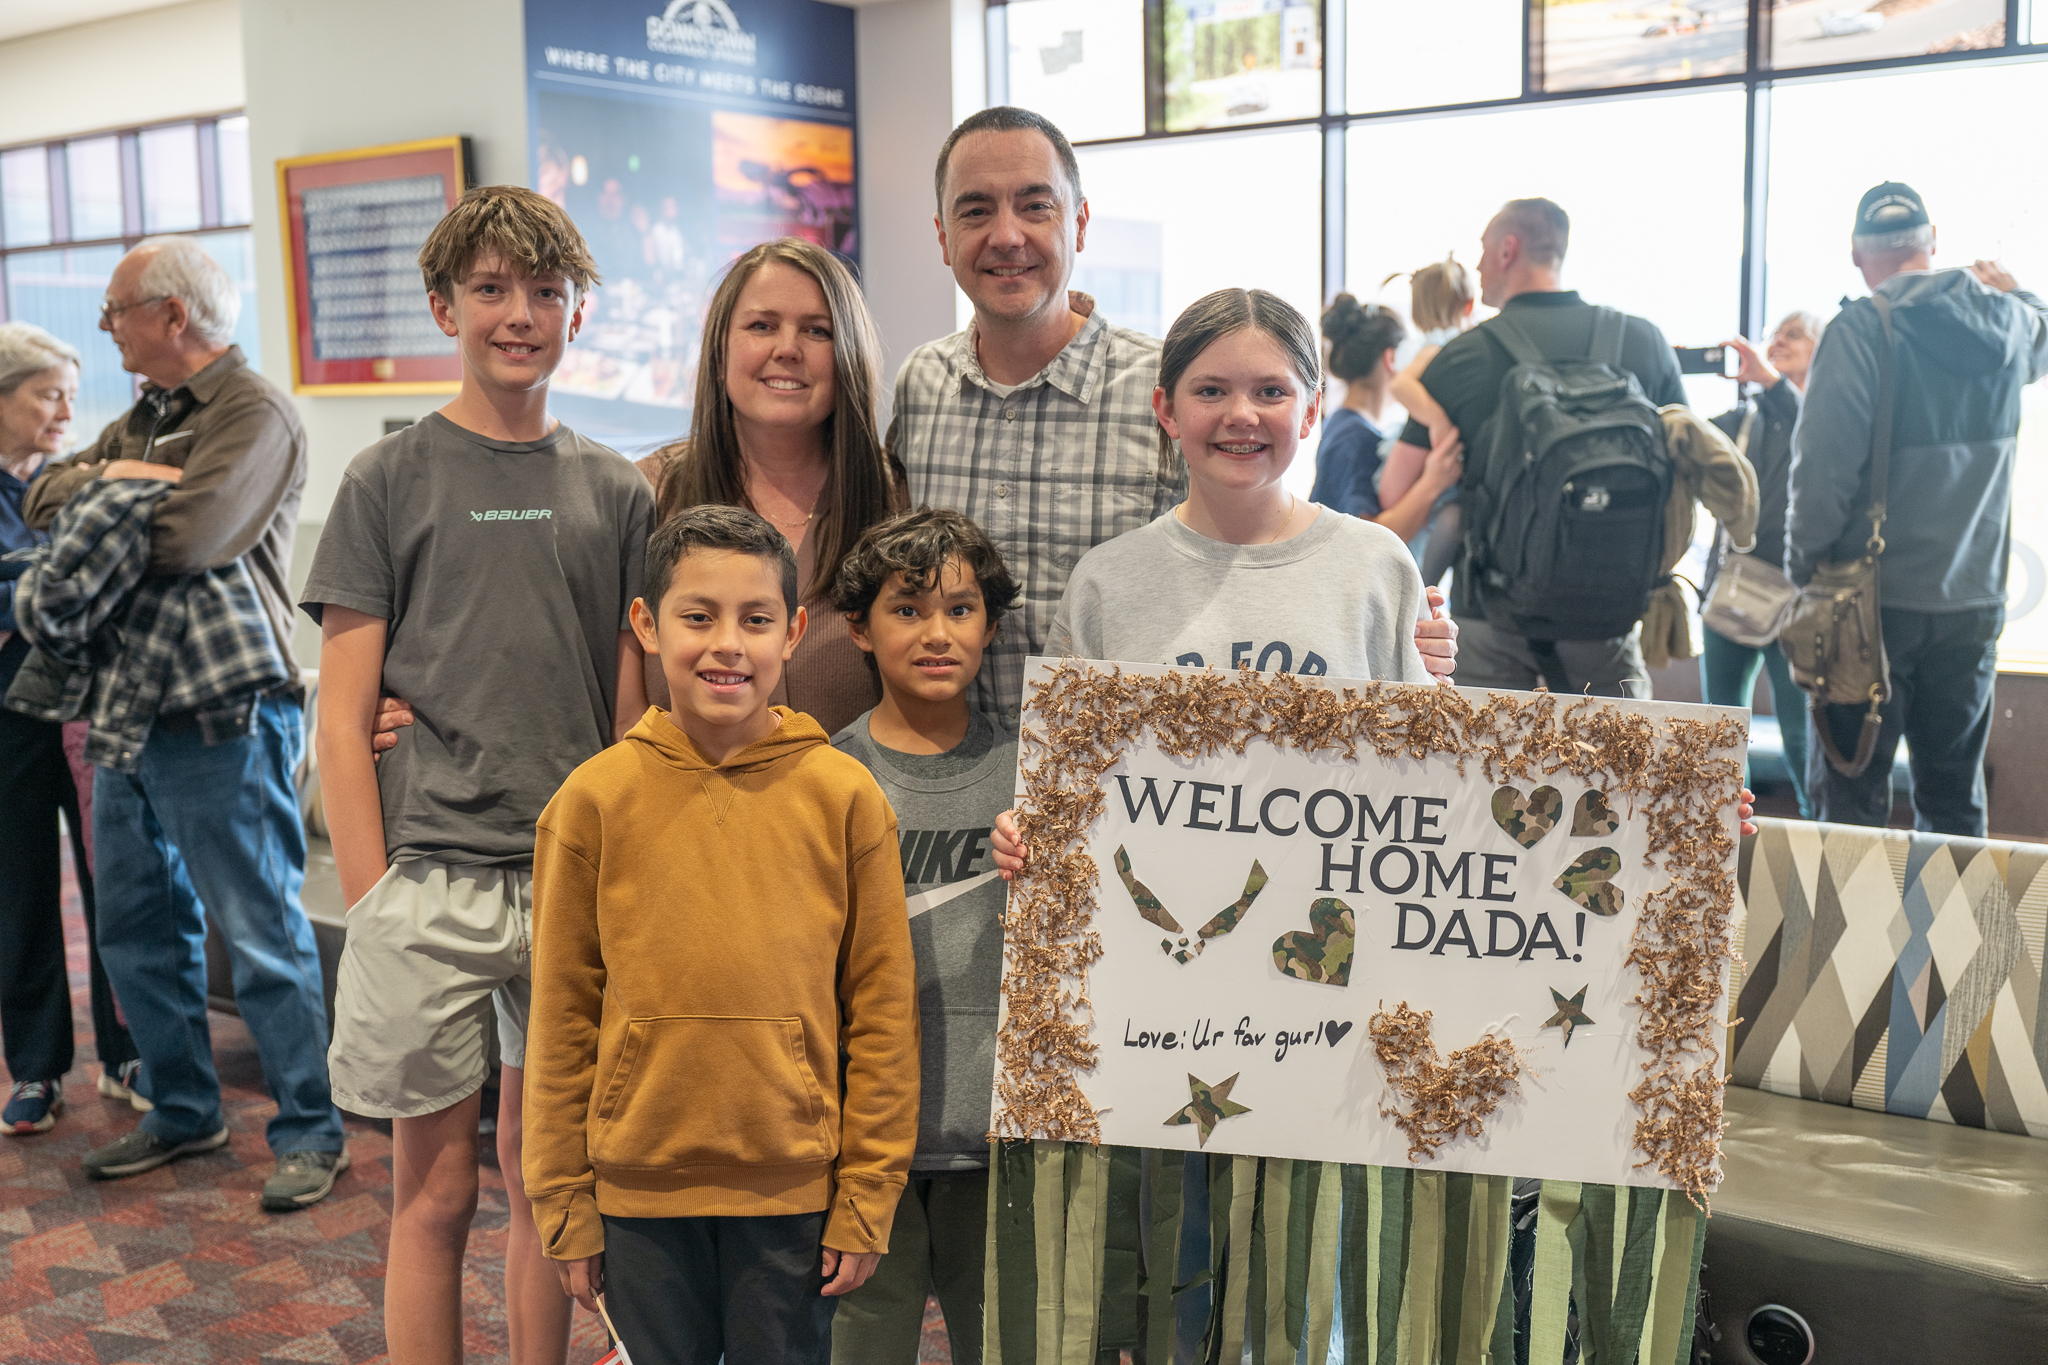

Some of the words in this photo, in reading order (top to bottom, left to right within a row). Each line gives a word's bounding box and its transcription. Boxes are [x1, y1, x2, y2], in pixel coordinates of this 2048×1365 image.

[545, 46, 610, 74] WHERE
[613, 56, 651, 80] THE
[654, 62, 697, 87] CITY
[760, 77, 793, 101] THE
[1114, 774, 1448, 846] WELCOME
[1316, 843, 1517, 902] HOME
[1391, 902, 1586, 963] DADA!
[1192, 1018, 1224, 1051] Ur
[1234, 1016, 1266, 1046] fav
